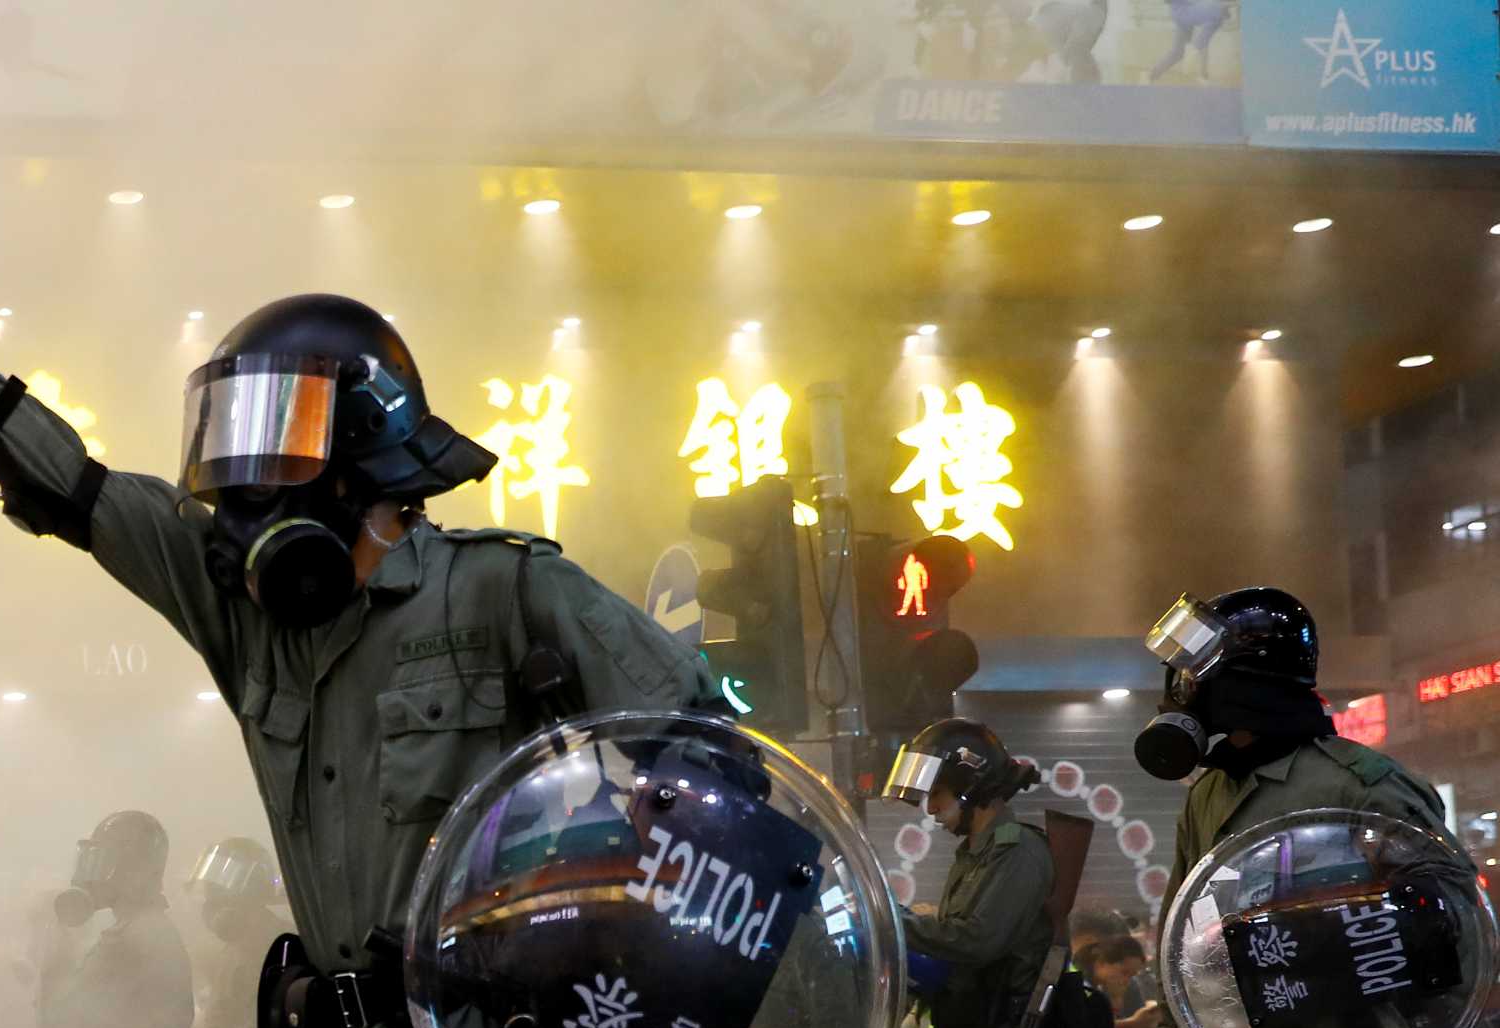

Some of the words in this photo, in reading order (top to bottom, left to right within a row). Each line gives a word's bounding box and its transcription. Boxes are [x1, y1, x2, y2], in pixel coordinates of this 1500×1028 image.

[1377, 74, 1438, 86] fitness
[900, 90, 1002, 124] DANCE
[1265, 112, 1477, 136] www.aplusfitness.hk
[80, 642, 149, 676] LAO
[624, 826, 781, 961] POLICE
[1340, 903, 1413, 996] POLICE
